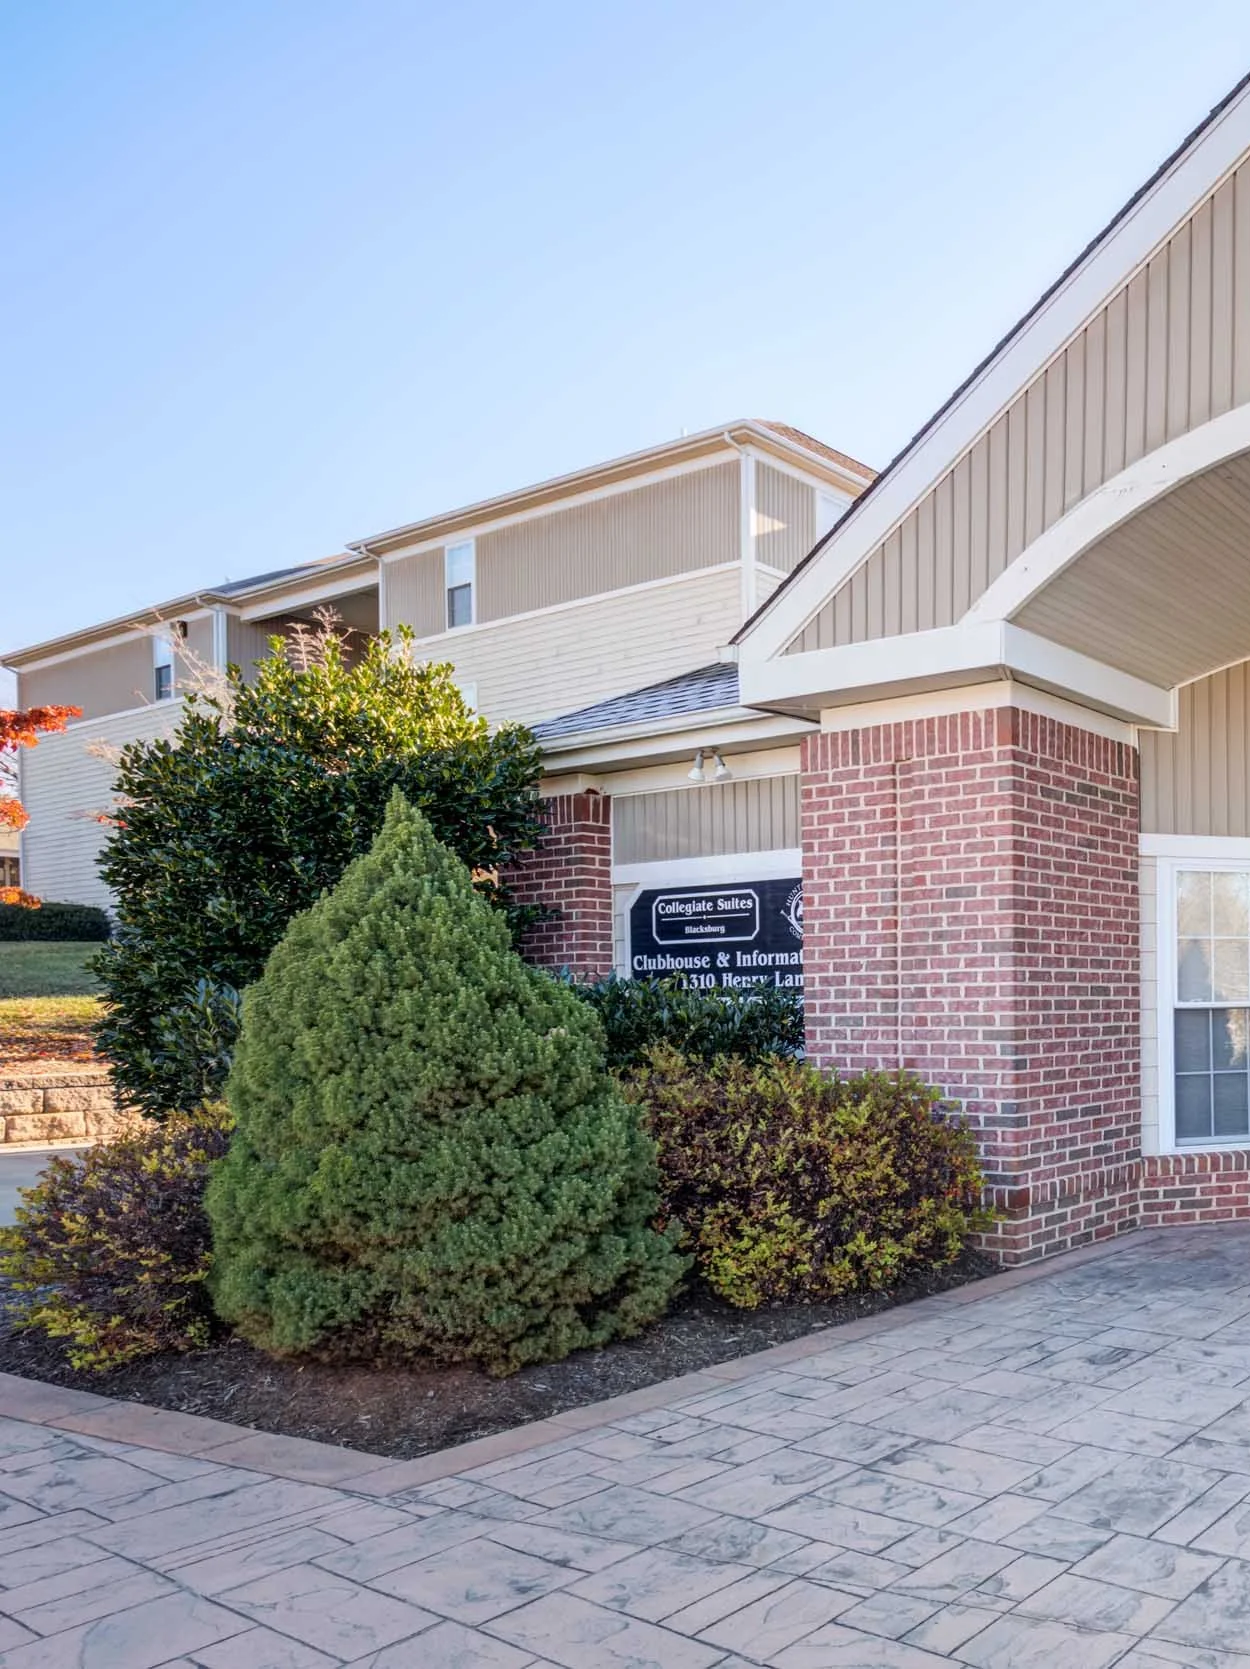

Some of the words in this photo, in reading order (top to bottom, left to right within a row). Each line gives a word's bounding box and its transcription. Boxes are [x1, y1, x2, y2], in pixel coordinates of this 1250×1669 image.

[658, 901, 713, 915] Collegiate
[717, 898, 753, 911] Suites
[685, 925, 725, 934] Blacksburg
[633, 954, 711, 971] Clubhouse
[716, 952, 730, 967] &
